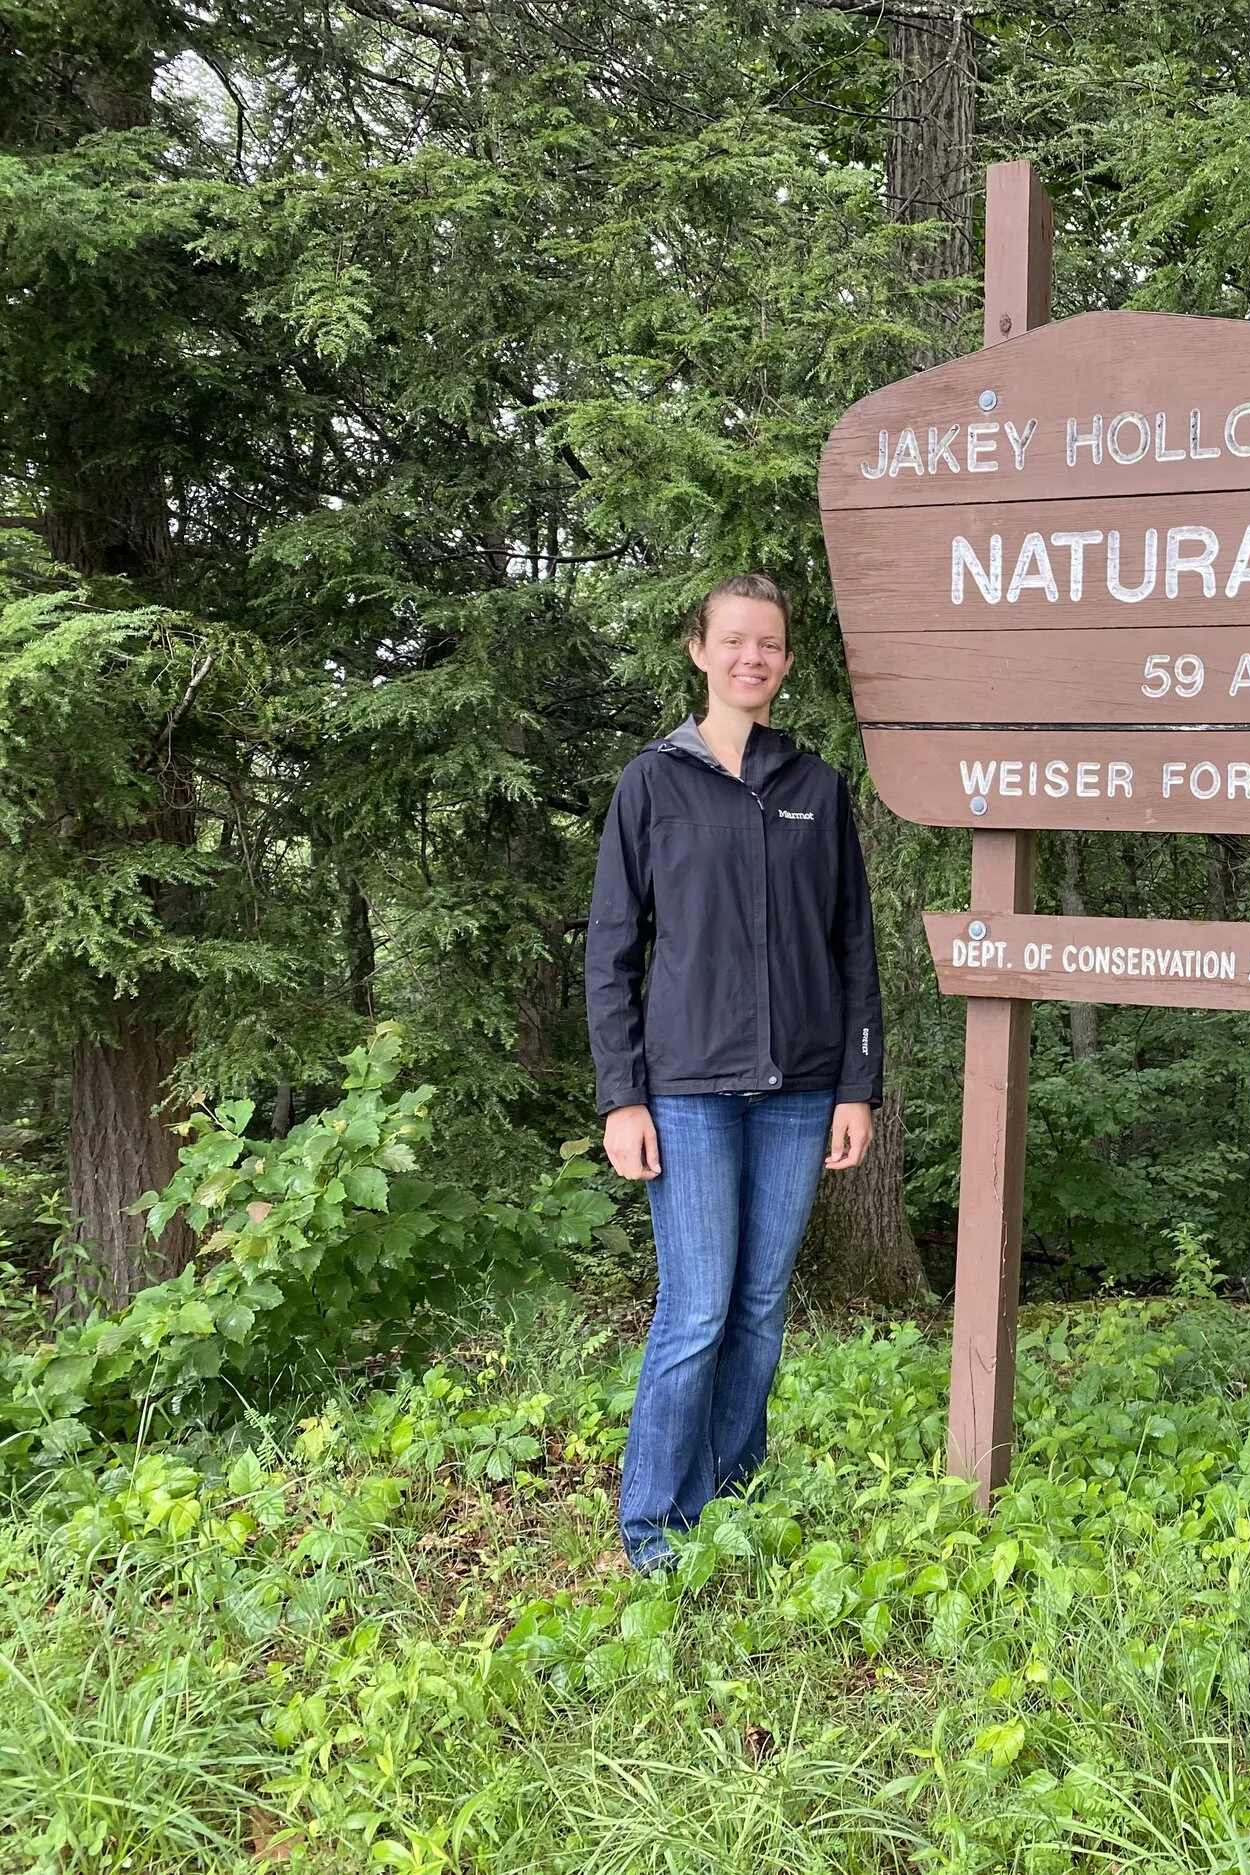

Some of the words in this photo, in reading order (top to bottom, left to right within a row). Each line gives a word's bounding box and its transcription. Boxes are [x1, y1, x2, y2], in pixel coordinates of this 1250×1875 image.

[861, 418, 1037, 479] JAKEY
[1141, 653, 1204, 698] 59
[960, 760, 1133, 798] WEISER
[778, 809, 814, 820] Marmot
[952, 939, 1013, 969] DEPT.
[1024, 942, 1052, 970] OF
[1062, 944, 1236, 980] CONSERVATION
